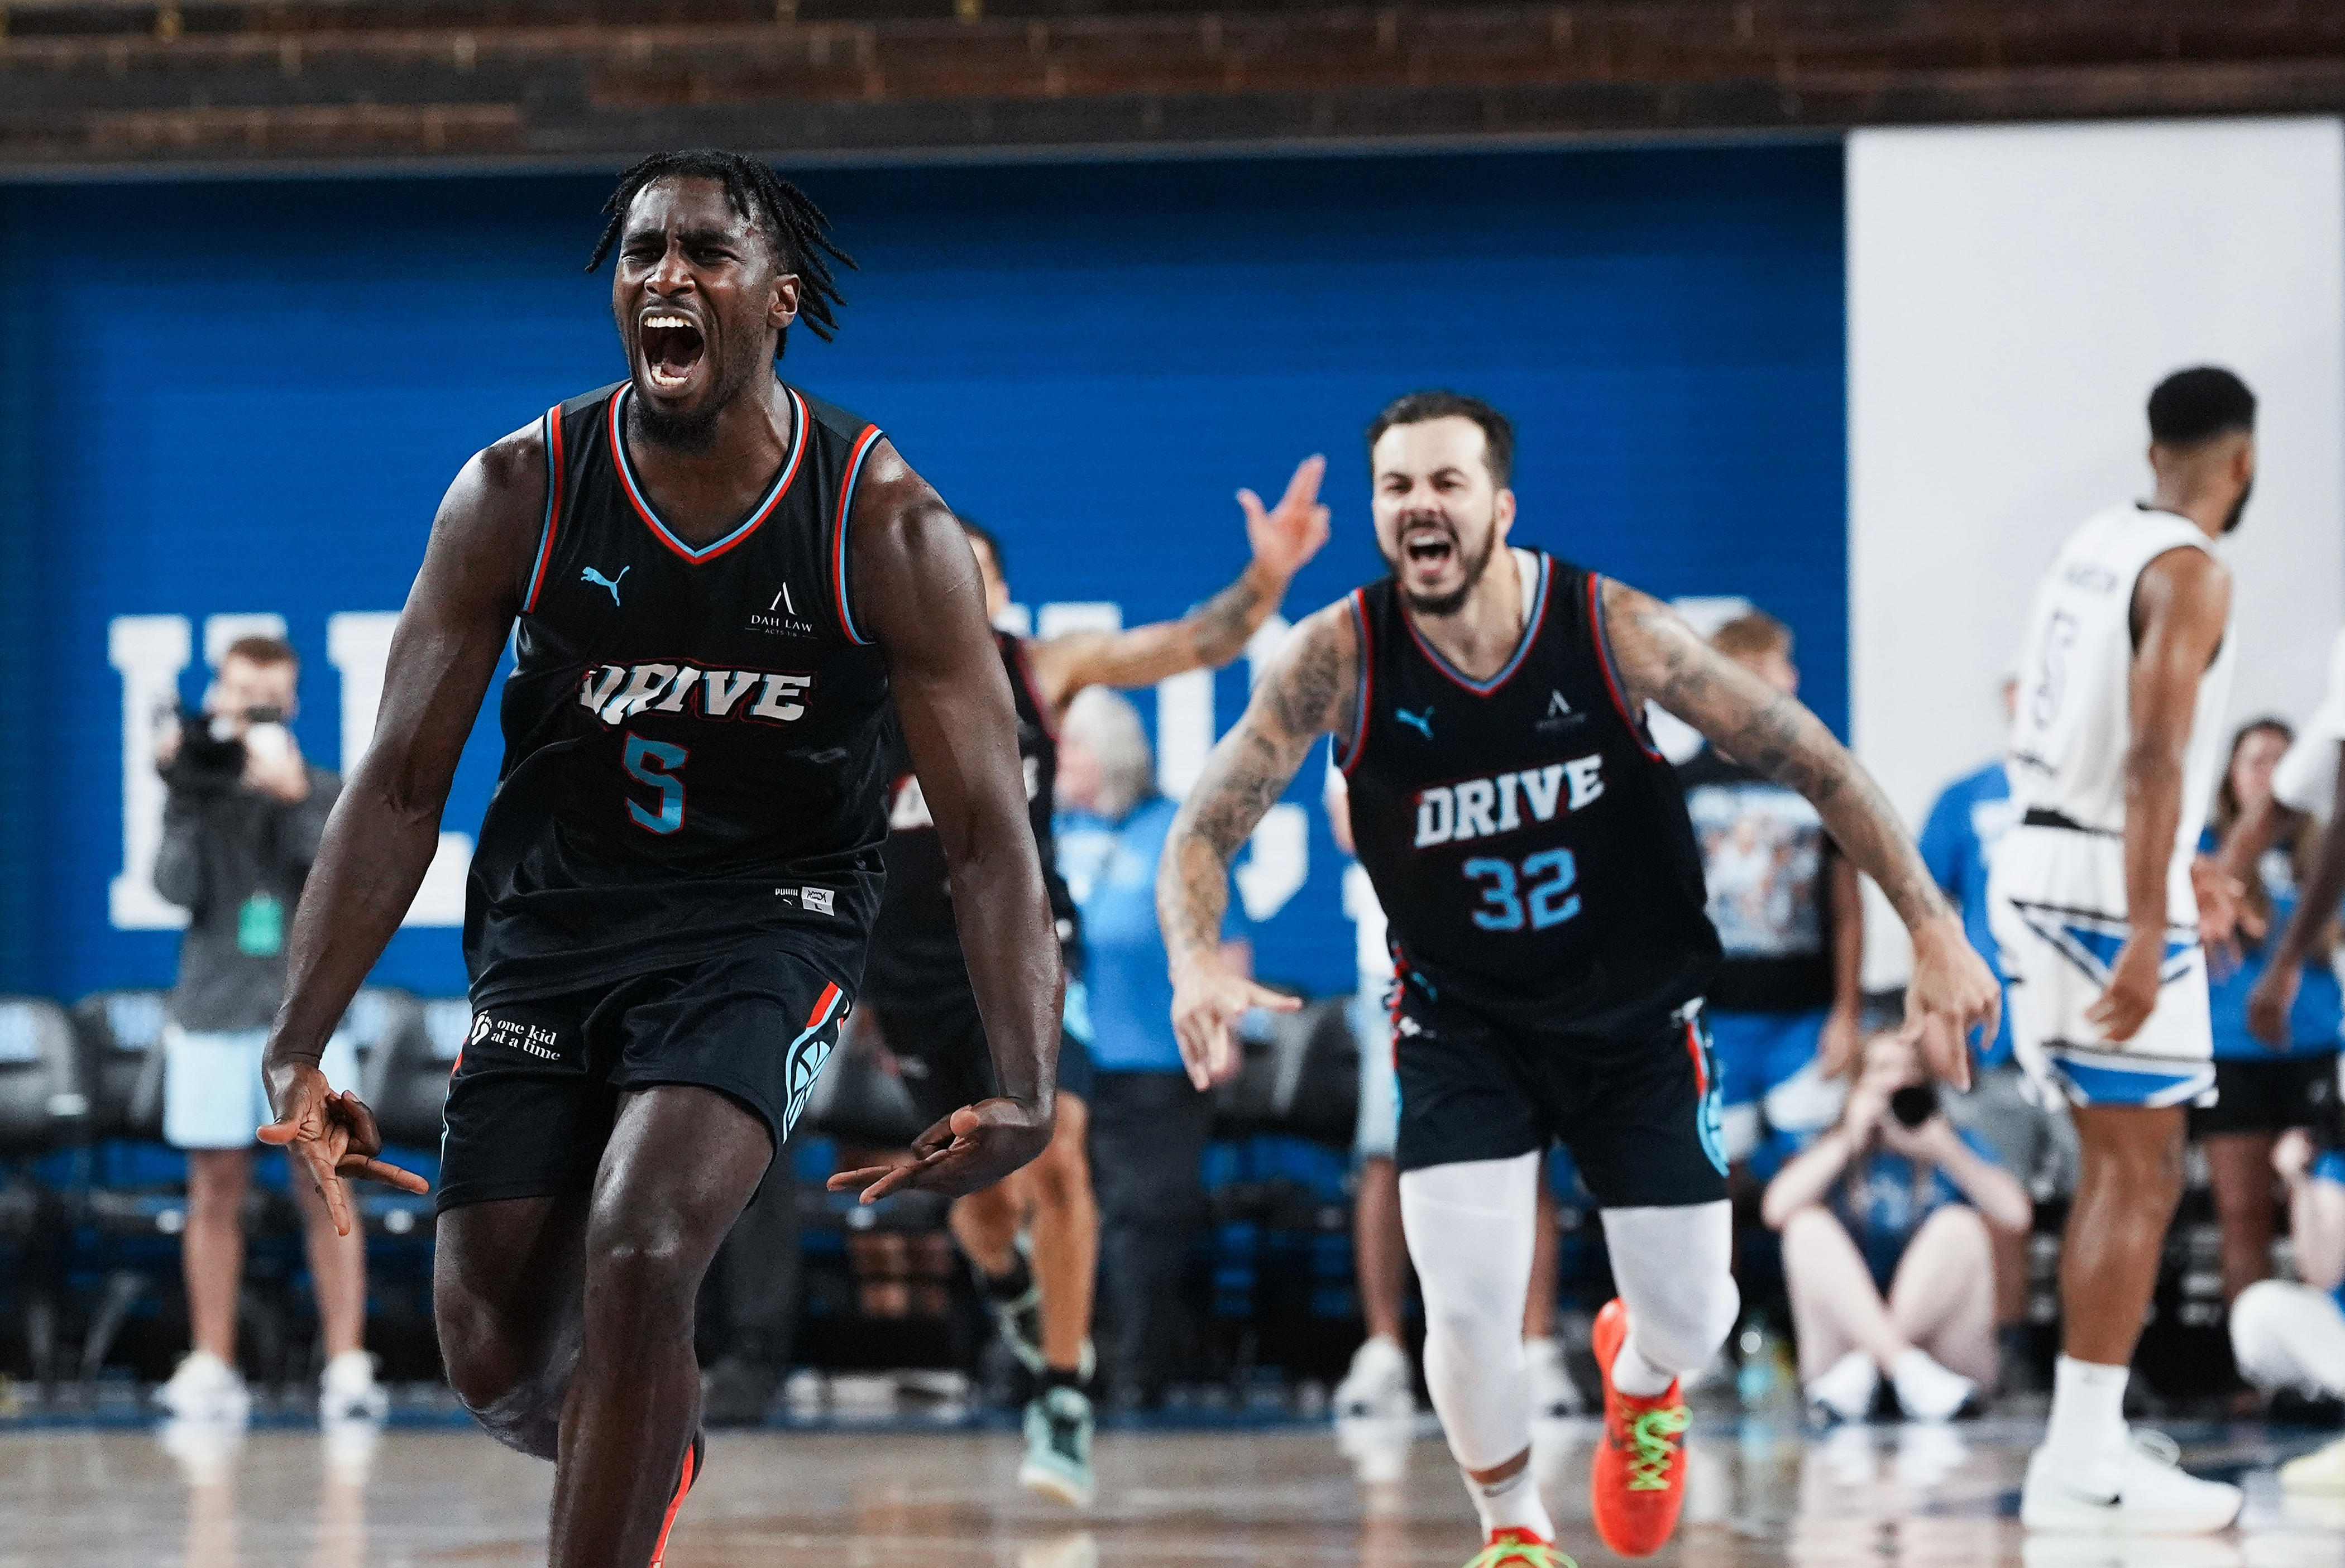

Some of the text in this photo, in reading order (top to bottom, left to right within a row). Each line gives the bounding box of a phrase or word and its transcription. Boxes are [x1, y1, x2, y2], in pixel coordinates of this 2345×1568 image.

[751, 615, 812, 632] DAH LAW
[579, 663, 811, 725] DRIVE
[621, 730, 691, 835] 5
[1414, 754, 1606, 848] DRIVE
[1462, 847, 1582, 931] 32
[490, 1031, 561, 1061] at a time
[497, 1019, 557, 1046] one kid
